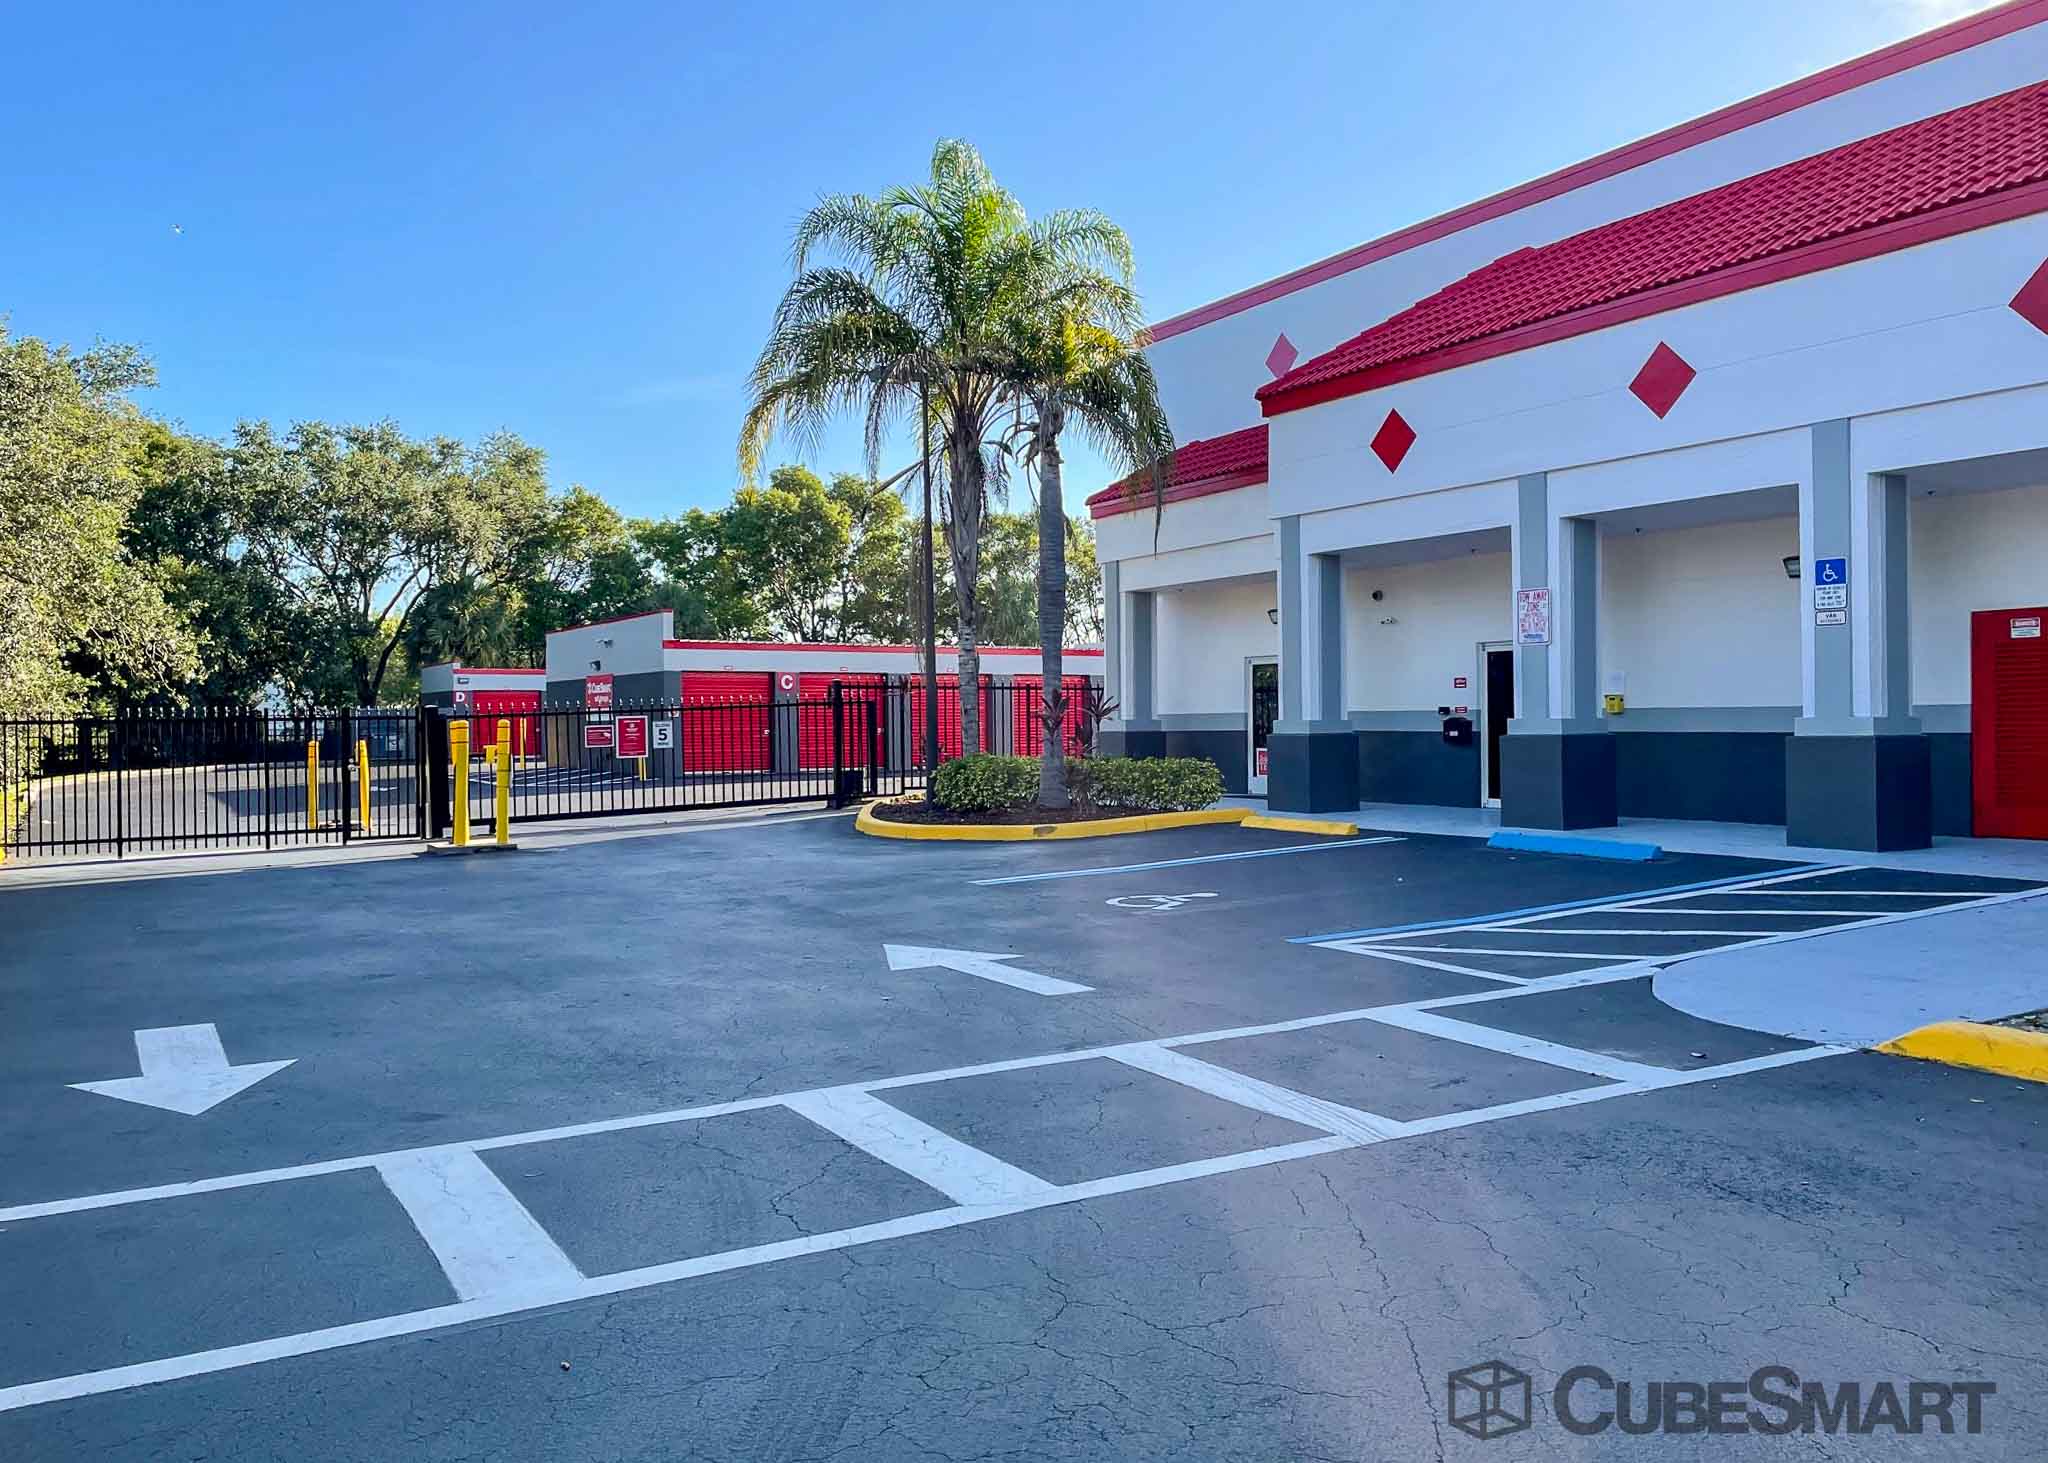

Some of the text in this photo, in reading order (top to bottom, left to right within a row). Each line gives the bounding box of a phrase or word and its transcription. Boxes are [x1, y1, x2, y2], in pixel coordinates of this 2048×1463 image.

[1532, 591, 1547, 601] AWAY
[780, 674, 794, 690] C
[455, 691, 465, 702] D
[658, 728, 668, 741] 5
